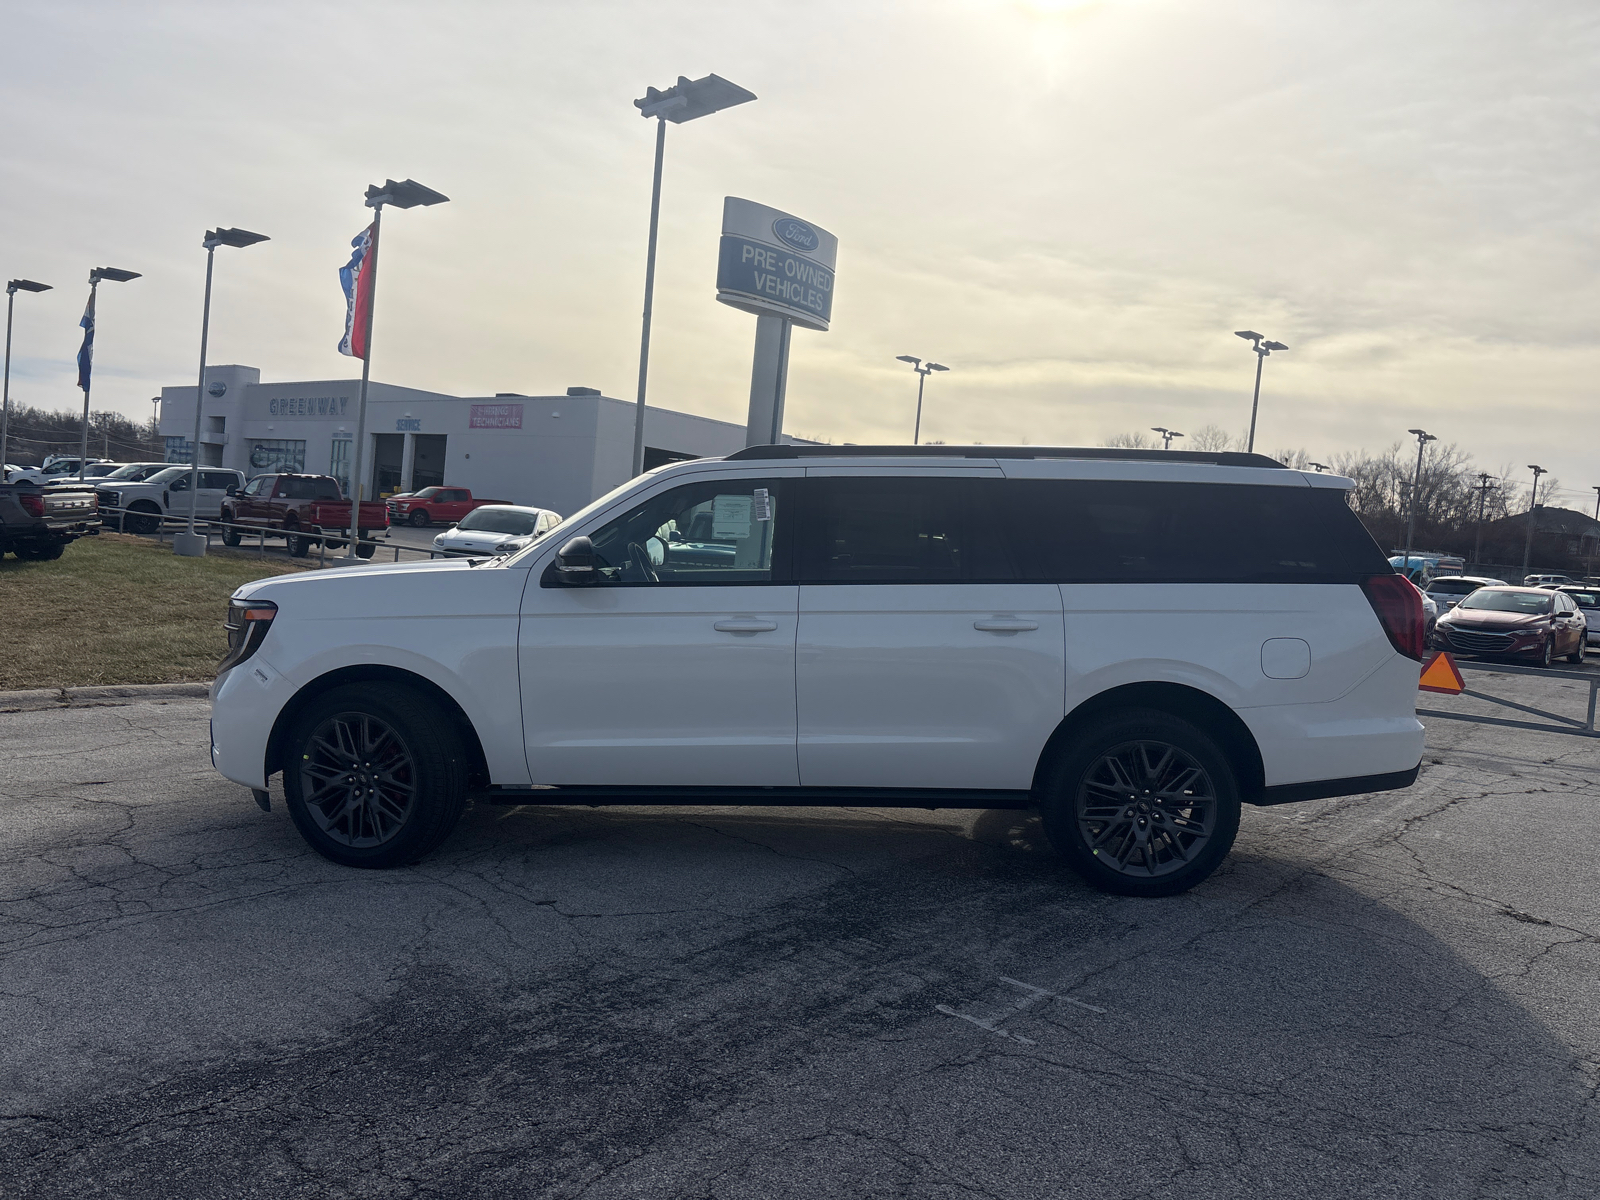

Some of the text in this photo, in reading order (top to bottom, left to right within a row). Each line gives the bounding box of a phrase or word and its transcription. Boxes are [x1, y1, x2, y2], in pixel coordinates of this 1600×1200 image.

[785, 223, 812, 246] Ford
[754, 271, 823, 311] VEHICLES
[269, 396, 349, 415] GREENWAY
[396, 418, 421, 431] SERVICE
[472, 417, 519, 427] TECHNICIANS
